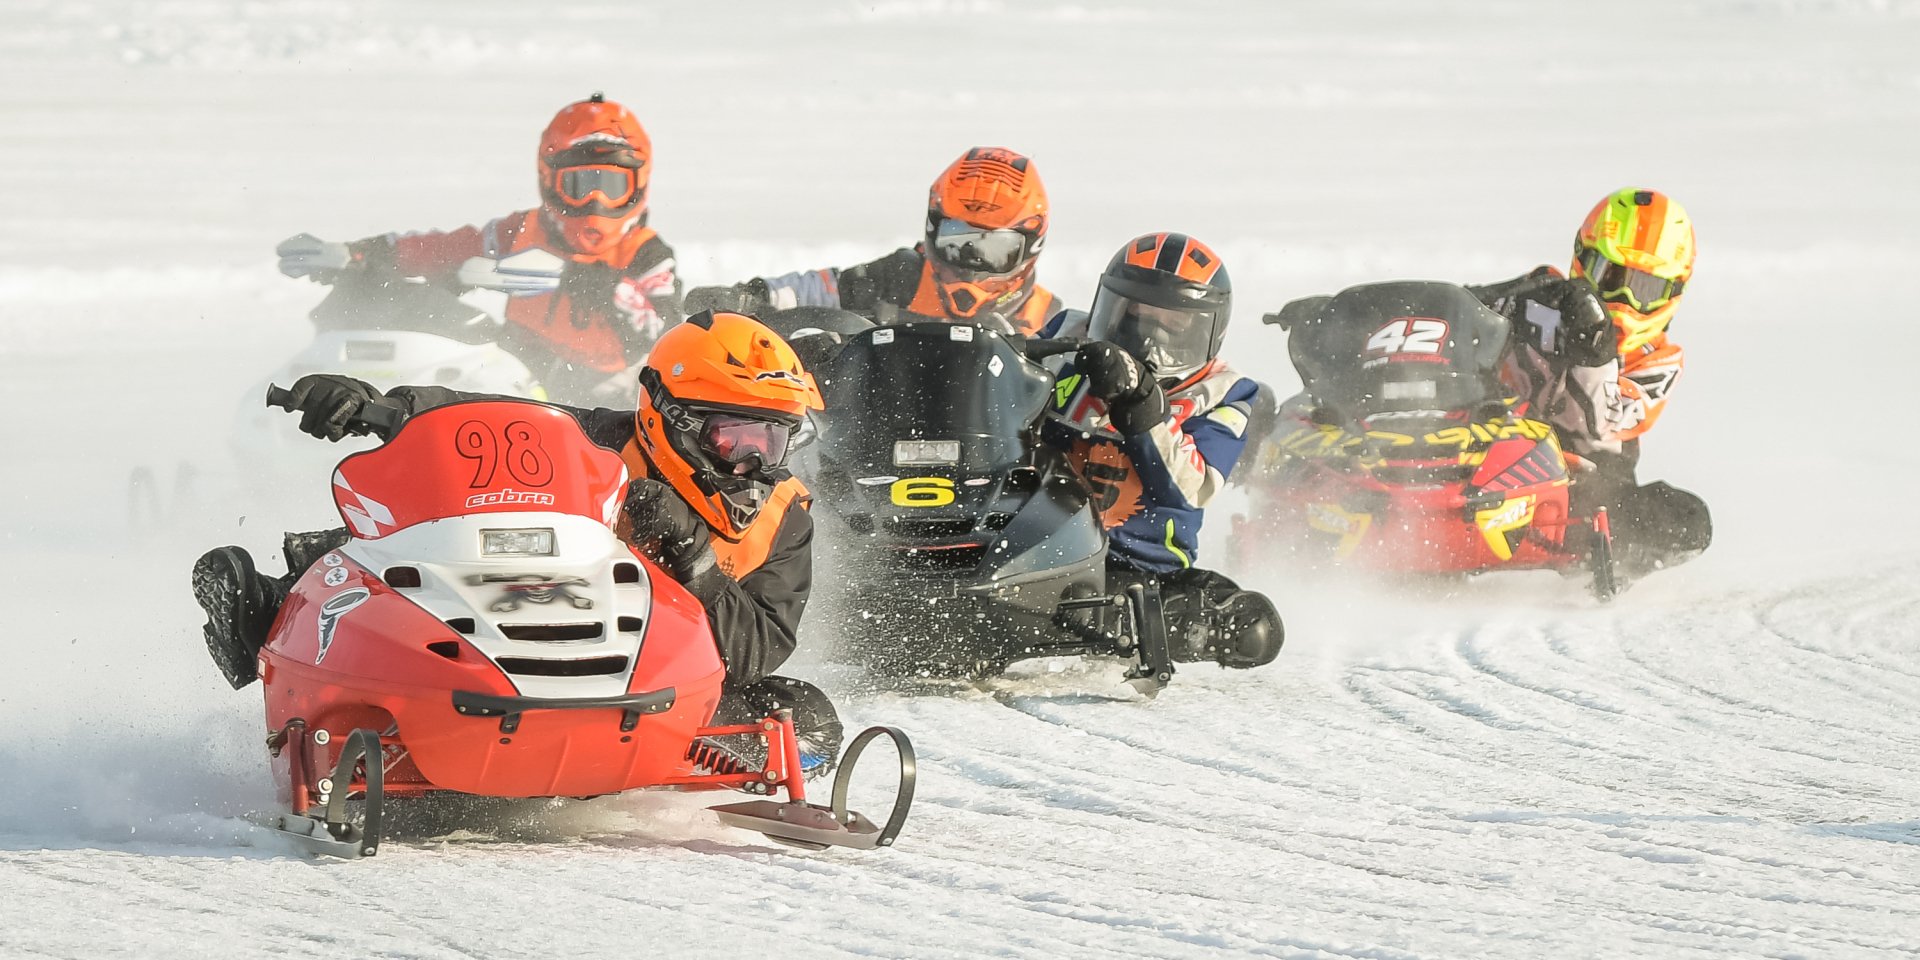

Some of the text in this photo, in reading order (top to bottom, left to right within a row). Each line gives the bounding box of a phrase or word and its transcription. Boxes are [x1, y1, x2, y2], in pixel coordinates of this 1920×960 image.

[1364, 317, 1449, 354] 42
[455, 420, 554, 488] 98
[465, 488, 555, 508] cobra
[891, 477, 955, 507] 6
